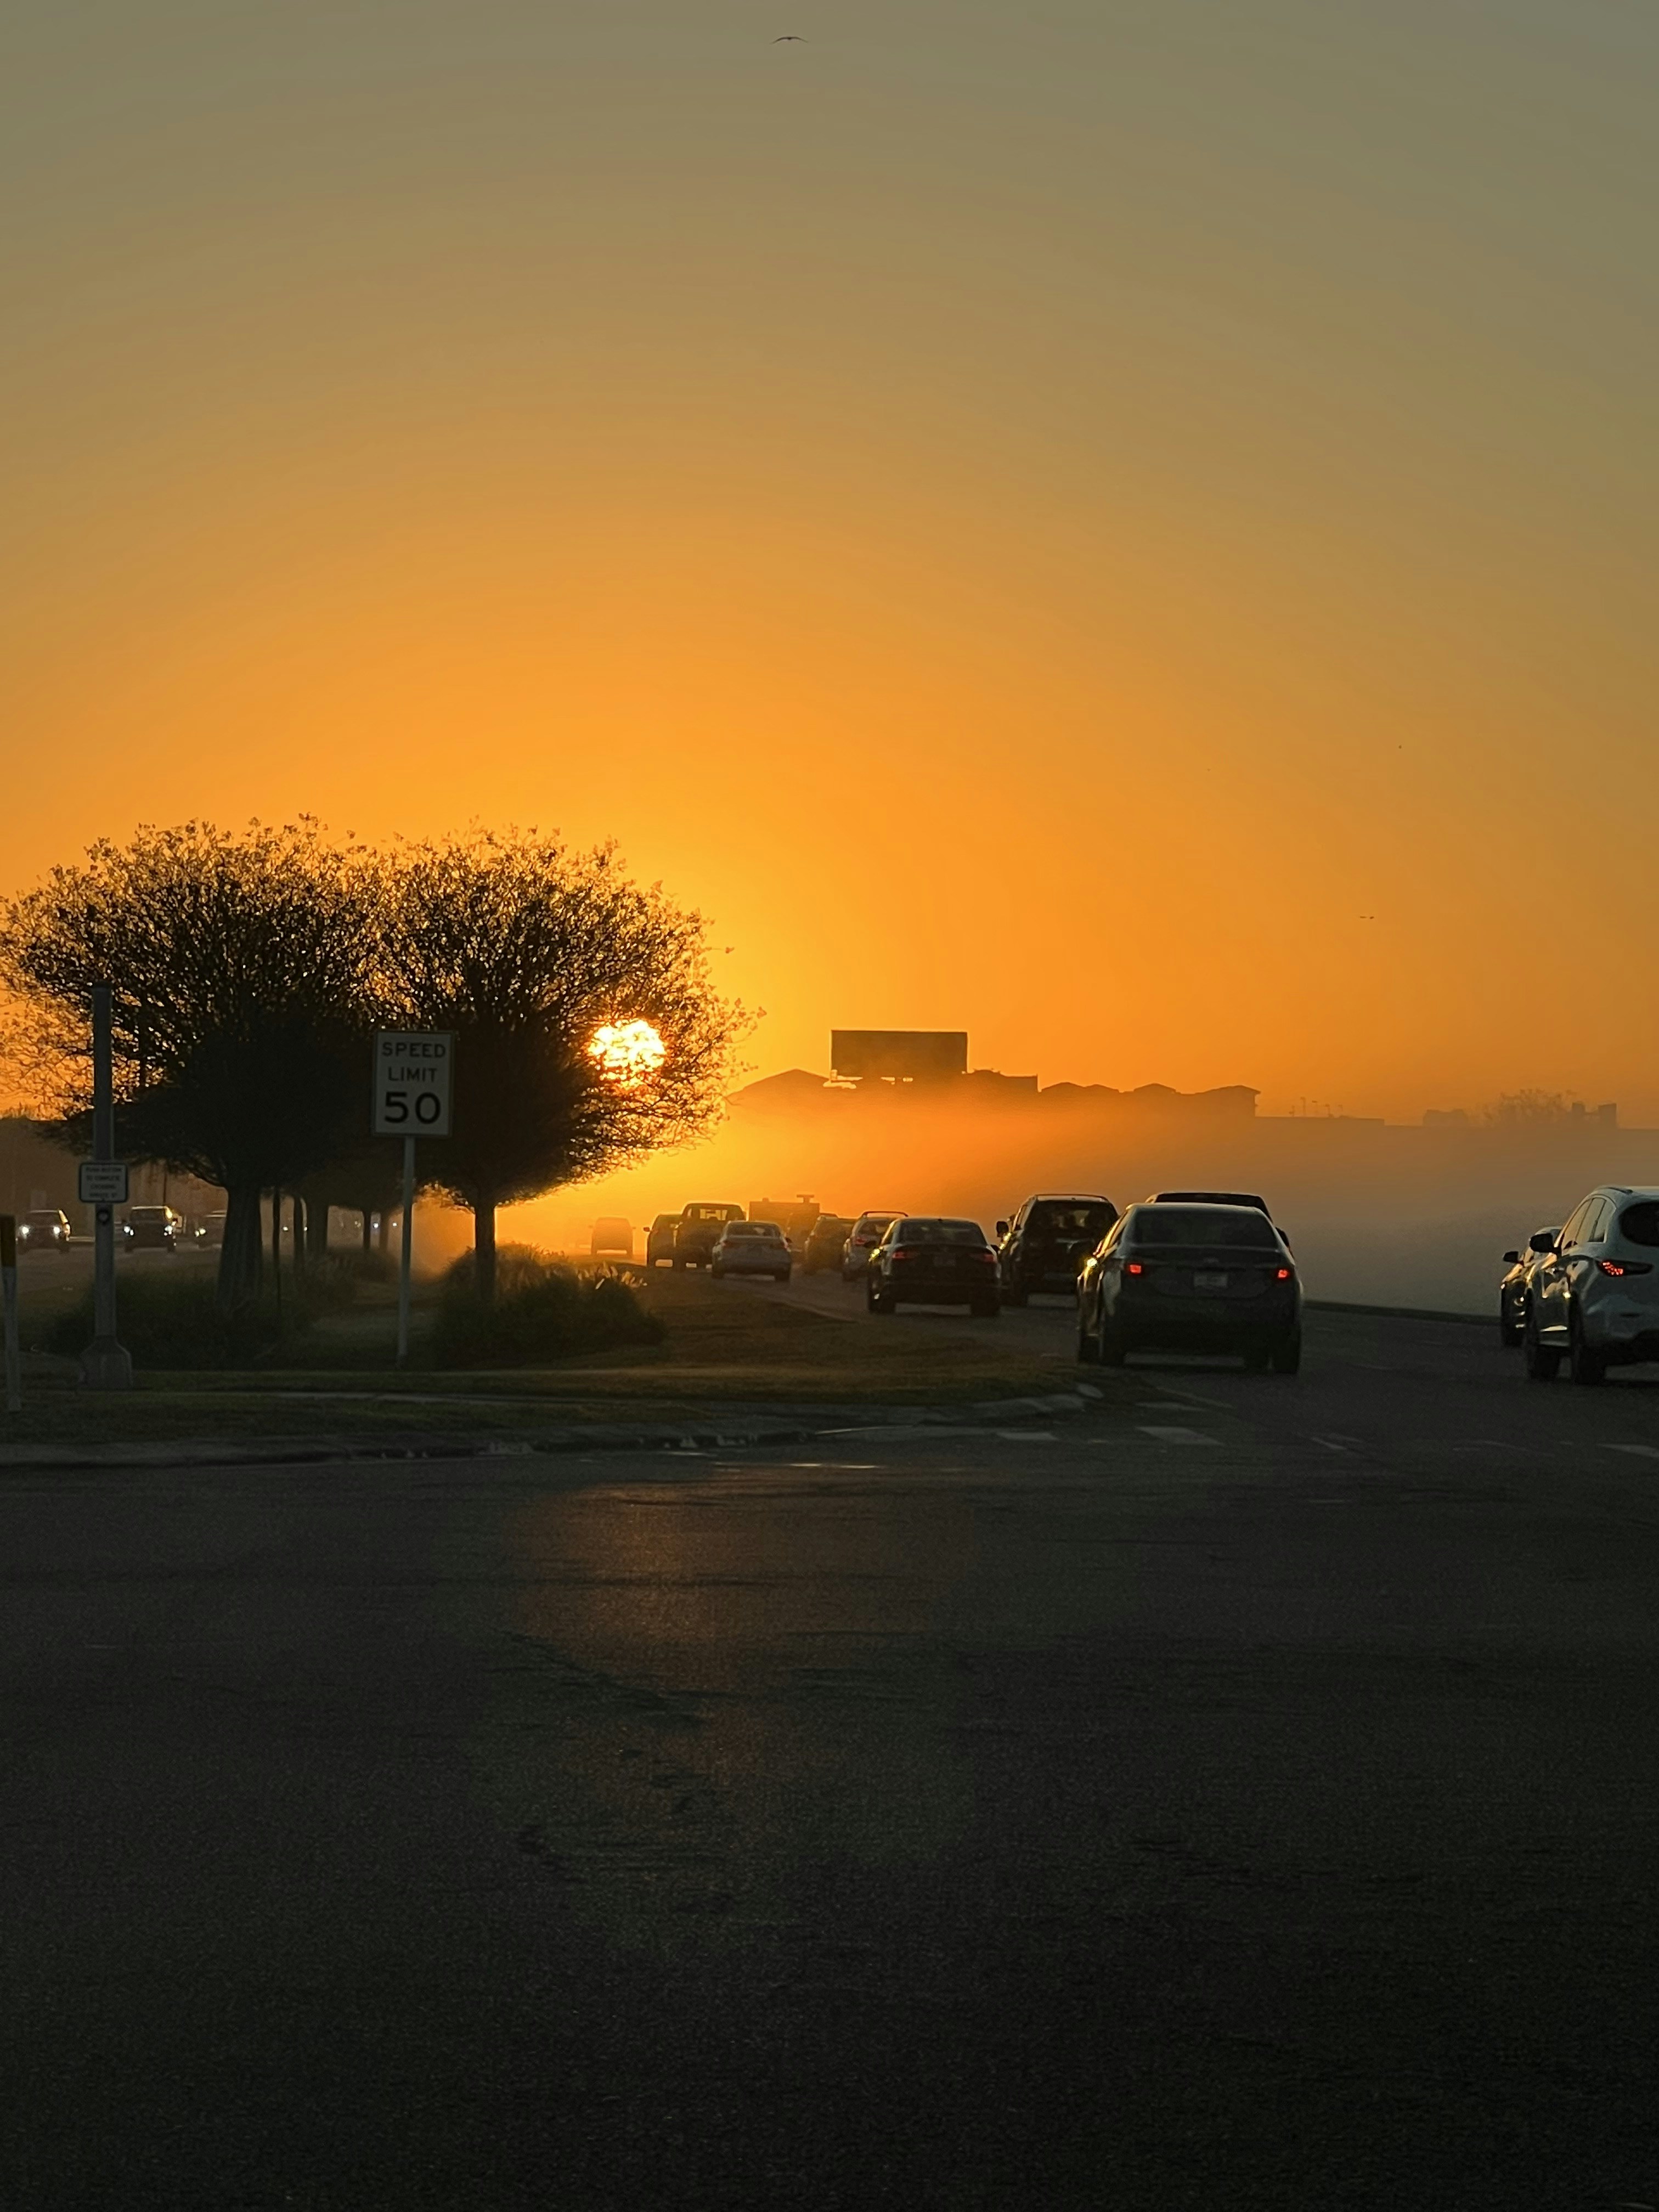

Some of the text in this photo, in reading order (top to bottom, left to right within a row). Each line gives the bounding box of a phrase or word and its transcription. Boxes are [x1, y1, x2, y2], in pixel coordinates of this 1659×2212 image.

[382, 1042, 446, 1058] SPEED
[388, 1066, 437, 1082] LIMIT
[385, 1091, 441, 1124] 50
